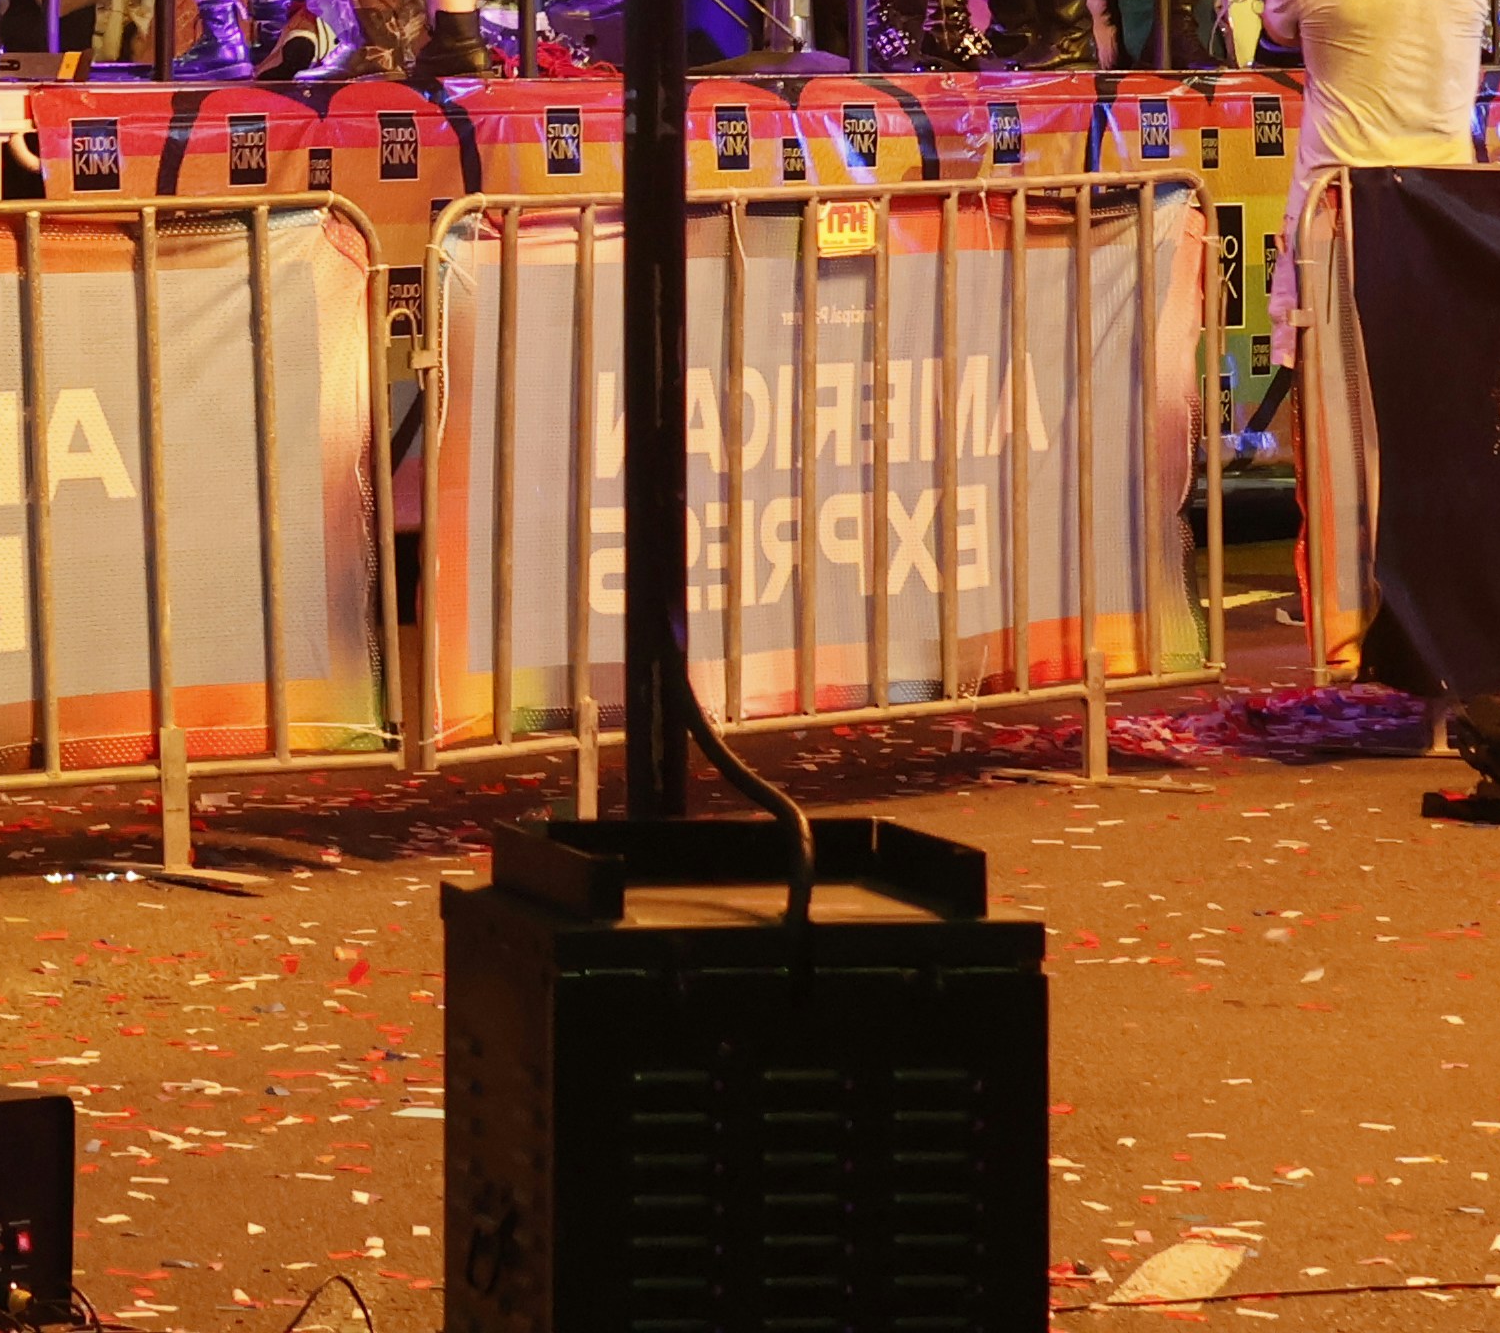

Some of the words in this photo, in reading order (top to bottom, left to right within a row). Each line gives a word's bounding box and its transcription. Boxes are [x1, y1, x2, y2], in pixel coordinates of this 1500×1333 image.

[1142, 112, 1168, 126] STUDIO
[1255, 111, 1281, 124] STUDIO
[548, 124, 579, 138] STUDIO
[717, 120, 748, 135] STUDIO
[845, 119, 877, 133] STUDIO
[1256, 124, 1282, 144] KINK
[231, 132, 265, 147] STUDIO
[382, 128, 416, 142] STUDIO
[1142, 127, 1169, 146] KINK
[74, 137, 117, 153] STUDIO
[548, 137, 579, 160] KINK
[718, 136, 748, 157] KINK
[845, 134, 876, 154] KINK
[231, 147, 265, 170] KINK
[382, 144, 416, 165] KINK
[74, 153, 118, 176] KINK
[389, 284, 421, 298] STUDIO
